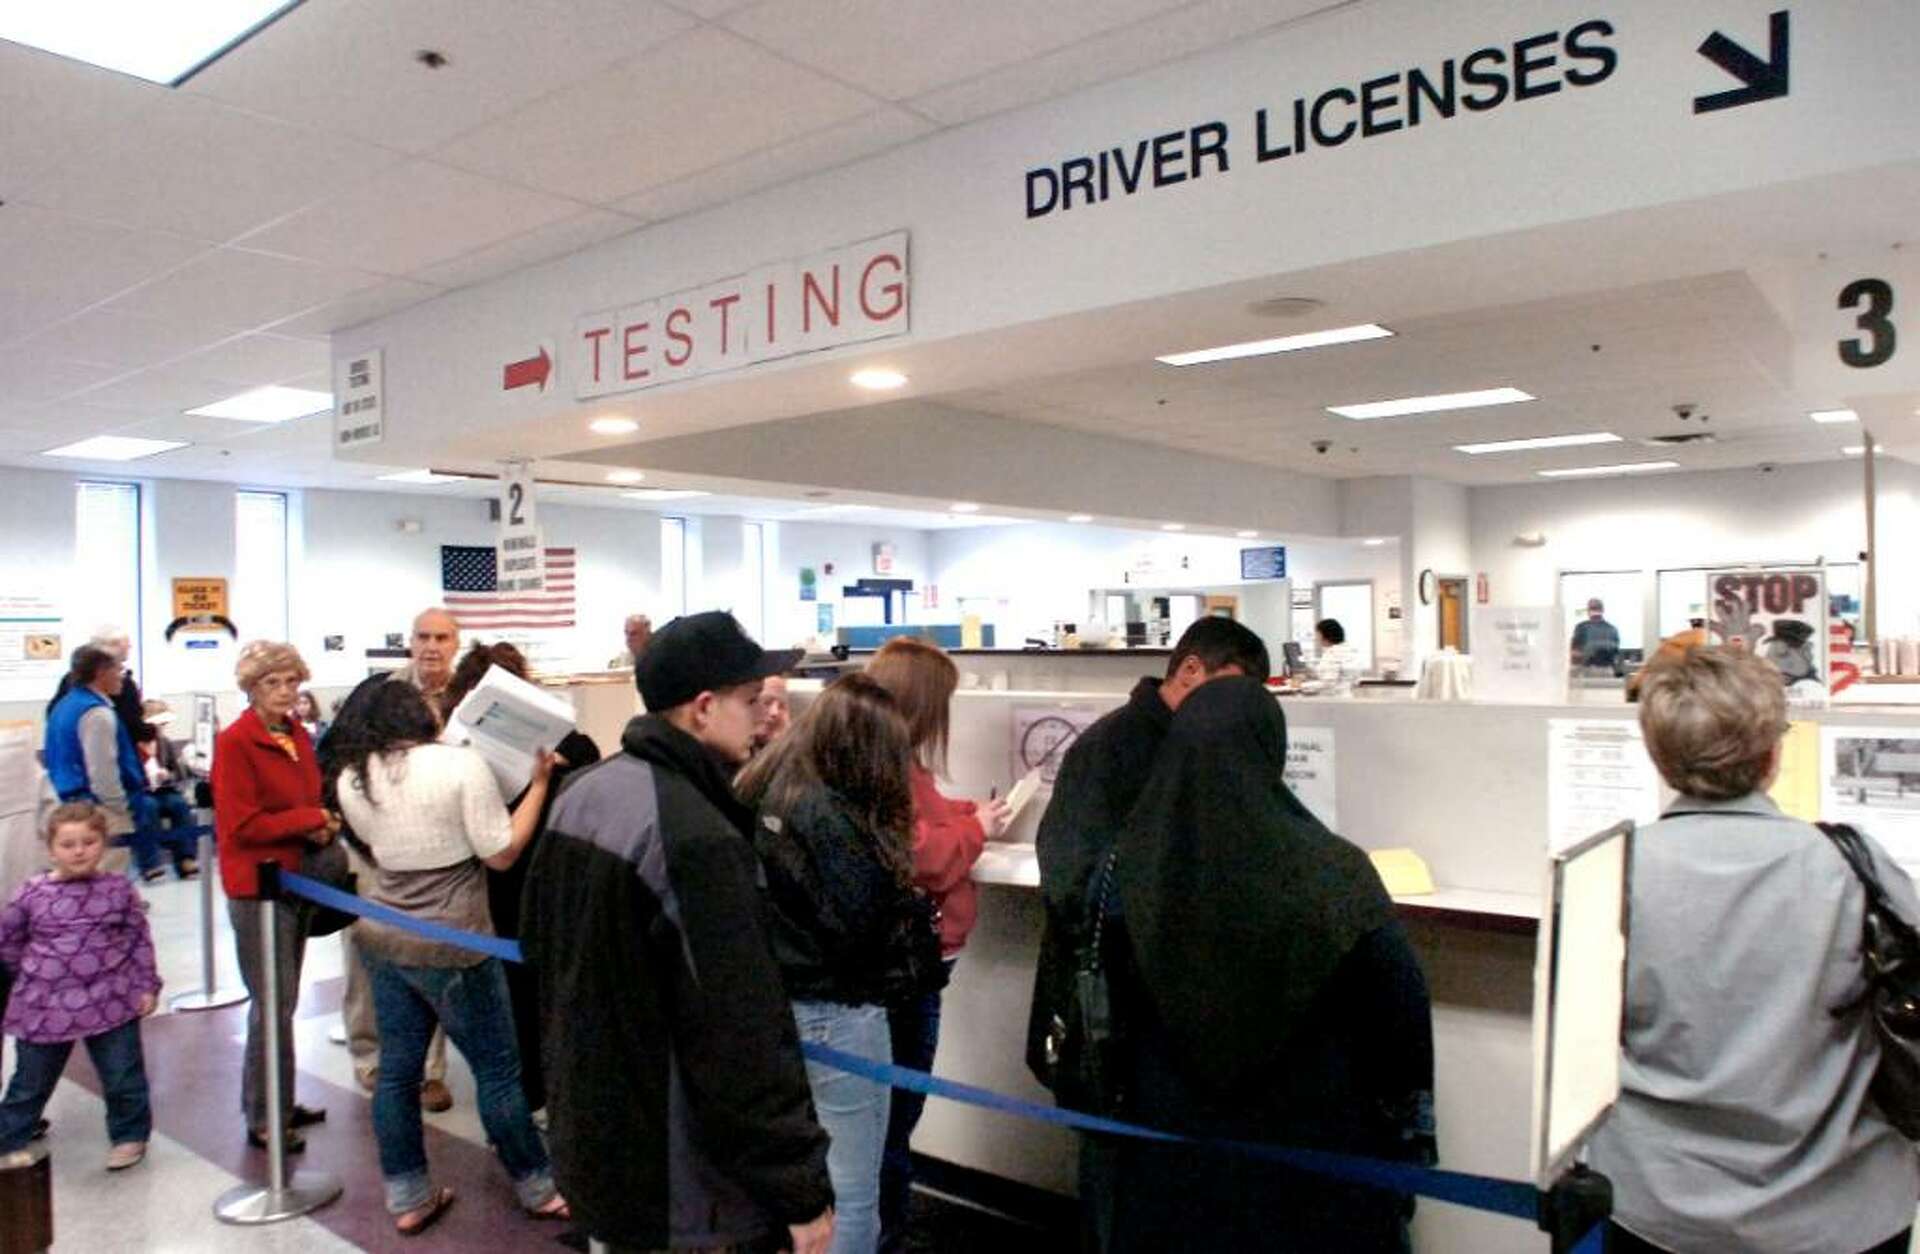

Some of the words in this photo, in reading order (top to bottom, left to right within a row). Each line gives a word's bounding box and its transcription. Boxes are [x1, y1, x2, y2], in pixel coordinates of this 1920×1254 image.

[1025, 120, 1229, 218] DRIVER
[1256, 18, 1619, 164] LICENSES
[583, 253, 904, 383] TESTING
[1837, 277, 1898, 369] 3
[509, 482, 524, 526] 2
[1714, 573, 1819, 616] STOP
